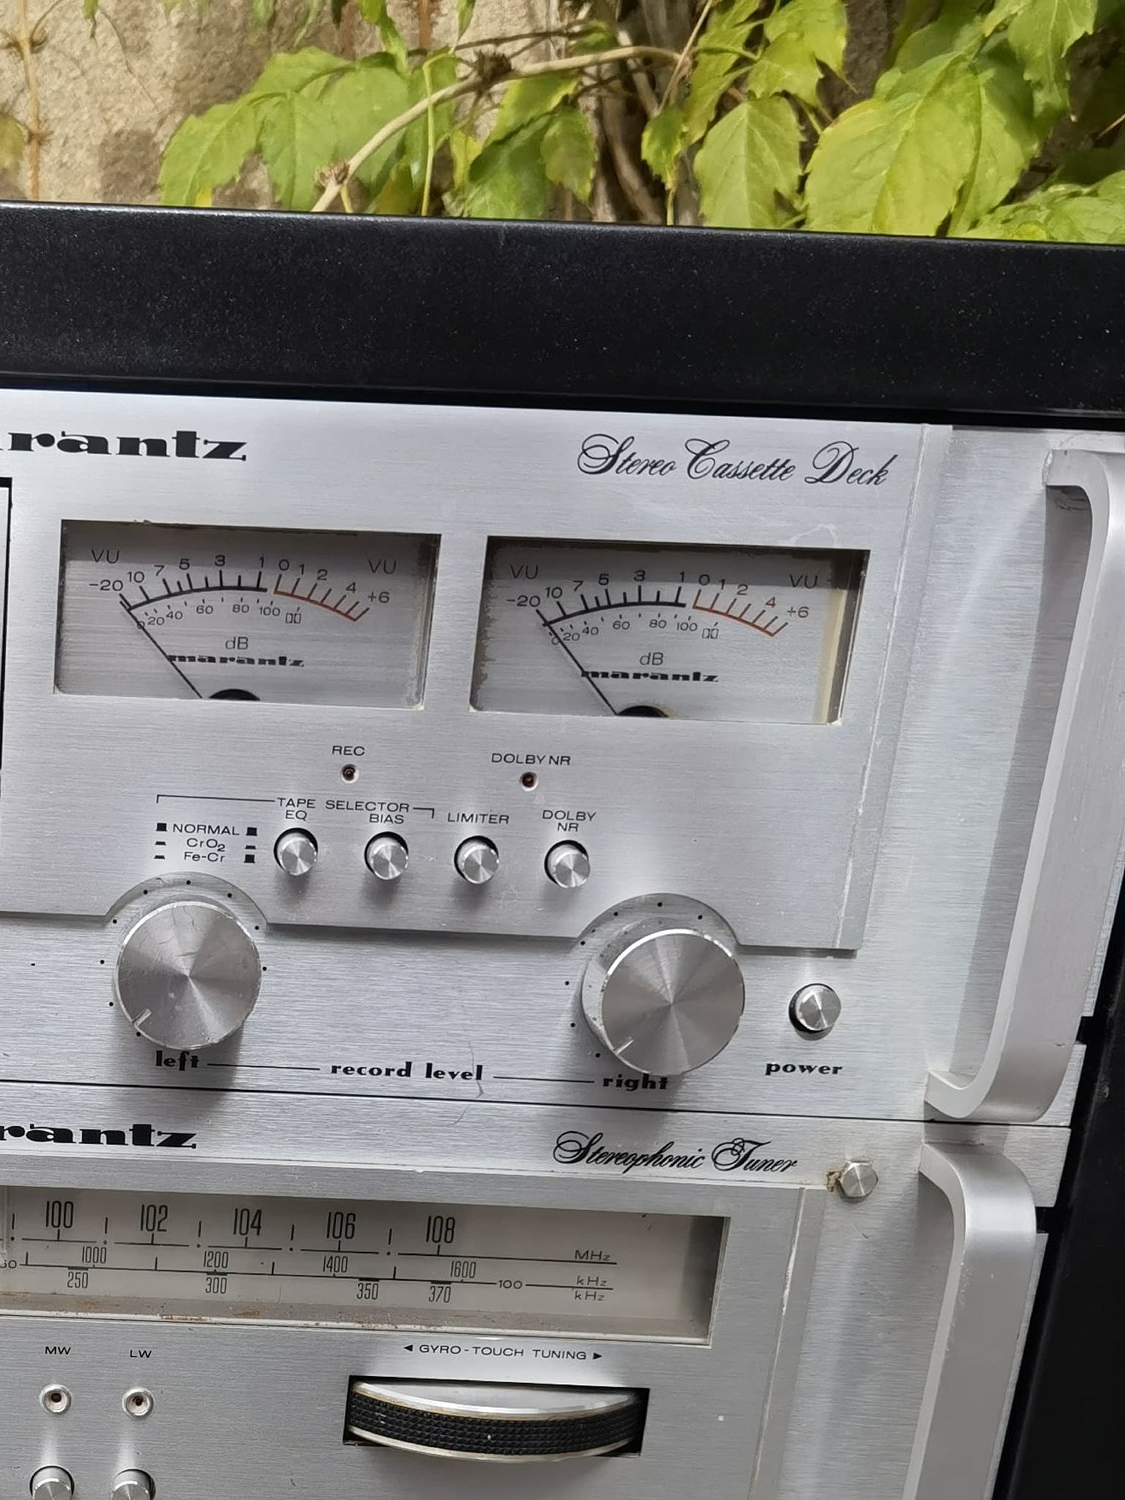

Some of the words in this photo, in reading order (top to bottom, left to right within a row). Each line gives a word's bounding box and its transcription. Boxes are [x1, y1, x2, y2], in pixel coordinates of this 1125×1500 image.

[577, 433, 677, 476] Stereo
[684, 438, 796, 482] Cassette
[804, 440, 898, 486] Deck
[91, 549, 120, 564] VU
[368, 559, 397, 575] VU
[510, 565, 539, 580] VU
[127, 571, 145, 584] 10
[367, 590, 390, 604] +6
[789, 574, 818, 590] VU
[225, 636, 249, 650] dB
[168, 655, 305, 667] marantz
[639, 652, 664, 666] dB
[582, 671, 719, 683] marantz
[331, 745, 365, 757] REC
[491, 753, 547, 765] DOLBY
[549, 755, 571, 766] NR
[277, 797, 316, 810] TAPE
[325, 800, 410, 813] SELECTOR
[285, 810, 307, 822] EQ
[369, 812, 405, 825] BIAS
[447, 812, 510, 825] LIMITER
[542, 810, 596, 822] DOLBY
[173, 823, 240, 836] NORMAL
[557, 822, 579, 833] NR
[183, 851, 225, 863] Fe-Cr
[155, 1050, 200, 1071] left
[331, 1060, 413, 1079] record
[425, 1062, 483, 1082] level
[765, 1060, 842, 1078] power
[602, 1072, 669, 1094] right
[554, 1130, 706, 1173] Stereophonic
[711, 1137, 798, 1174] Tuner
[45, 1200, 74, 1229] 100
[140, 1204, 168, 1232] 102
[233, 1208, 262, 1236] 104
[326, 1212, 355, 1240] 106
[426, 1216, 455, 1244] 108
[575, 1250, 611, 1262] MHz
[82, 1247, 107, 1264] 1000
[203, 1251, 229, 1269] 1200
[323, 1256, 348, 1274] 1400
[450, 1261, 476, 1279] 1600
[576, 1275, 608, 1287] kHz
[67, 1272, 89, 1289] 250
[205, 1277, 227, 1294] 300
[356, 1283, 379, 1300] 350
[428, 1285, 452, 1303] 370
[574, 1290, 605, 1302] kHz
[45, 1346, 71, 1355] MW
[130, 1350, 152, 1359] LW
[532, 1349, 587, 1360] TUNING
